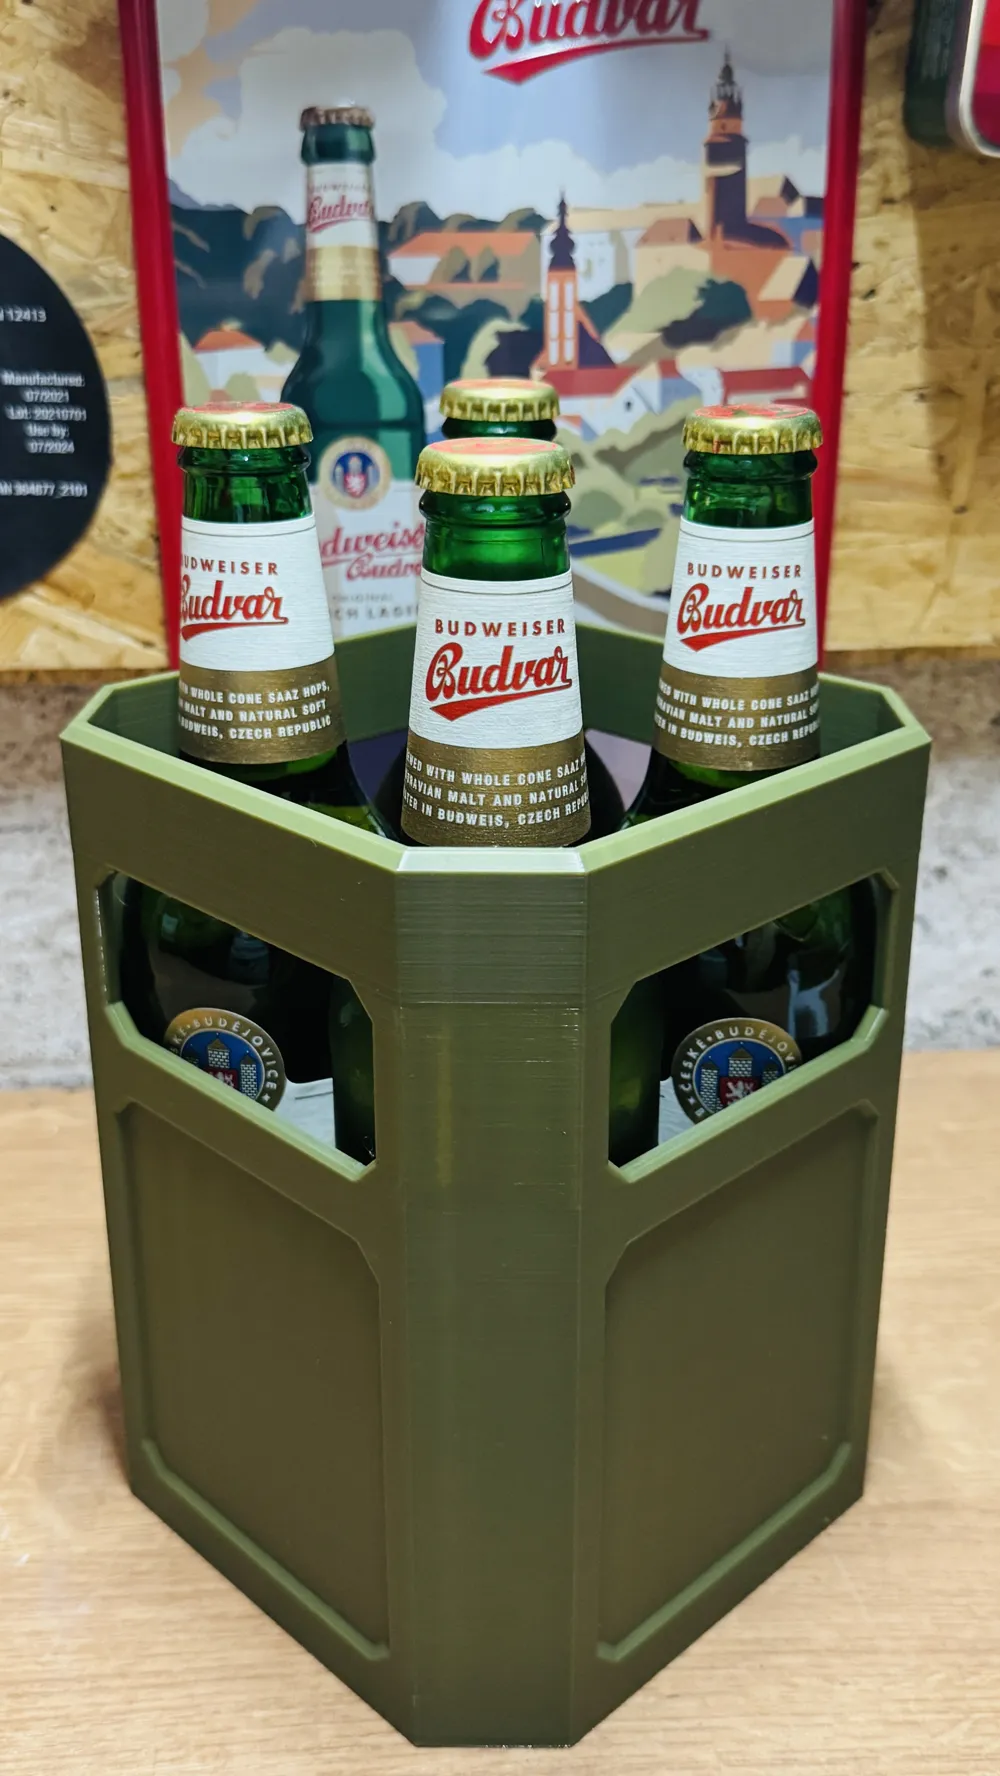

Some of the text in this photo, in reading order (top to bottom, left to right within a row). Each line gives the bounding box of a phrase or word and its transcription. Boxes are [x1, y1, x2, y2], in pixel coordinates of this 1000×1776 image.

[7, 307, 47, 322] 12413
[182, 554, 278, 575] UDWEISER
[687, 562, 801, 580] BUDWEISER
[676, 582, 806, 636] Budvar
[435, 618, 565, 637] BUDWEISER
[425, 641, 573, 702] Budvar
[190, 686, 223, 703] WHOLE
[228, 692, 262, 704] CONE
[268, 688, 299, 703] SAAZ
[303, 680, 330, 698] HOPS,
[673, 688, 697, 706] WITH
[701, 696, 745, 711] WHOLE
[751, 697, 782, 711] CONE
[184, 700, 206, 718] MALT
[209, 708, 233, 722] AND
[239, 707, 298, 722] NATURAL
[302, 698, 327, 716] SOFT
[689, 711, 722, 728] MALT
[727, 716, 755, 729] AND
[760, 709, 808, 728] NATURAL
[229, 727, 272, 740] CZECH
[278, 715, 331, 737] REPUBLIC
[667, 722, 677, 736] IN
[680, 727, 742, 748] BUDWEIS,
[749, 730, 789, 746] CZECH
[426, 763, 455, 783] WITH
[461, 771, 510, 786] WHOLE
[517, 768, 552, 786] CONE
[557, 759, 579, 778] SAAZ
[447, 789, 487, 807] MALT
[492, 793, 522, 807] AND
[529, 779, 579, 804] NATURAL
[421, 802, 433, 817] IN
[437, 807, 510, 829] BUDWEIS,
[518, 806, 560, 825] CZECH
